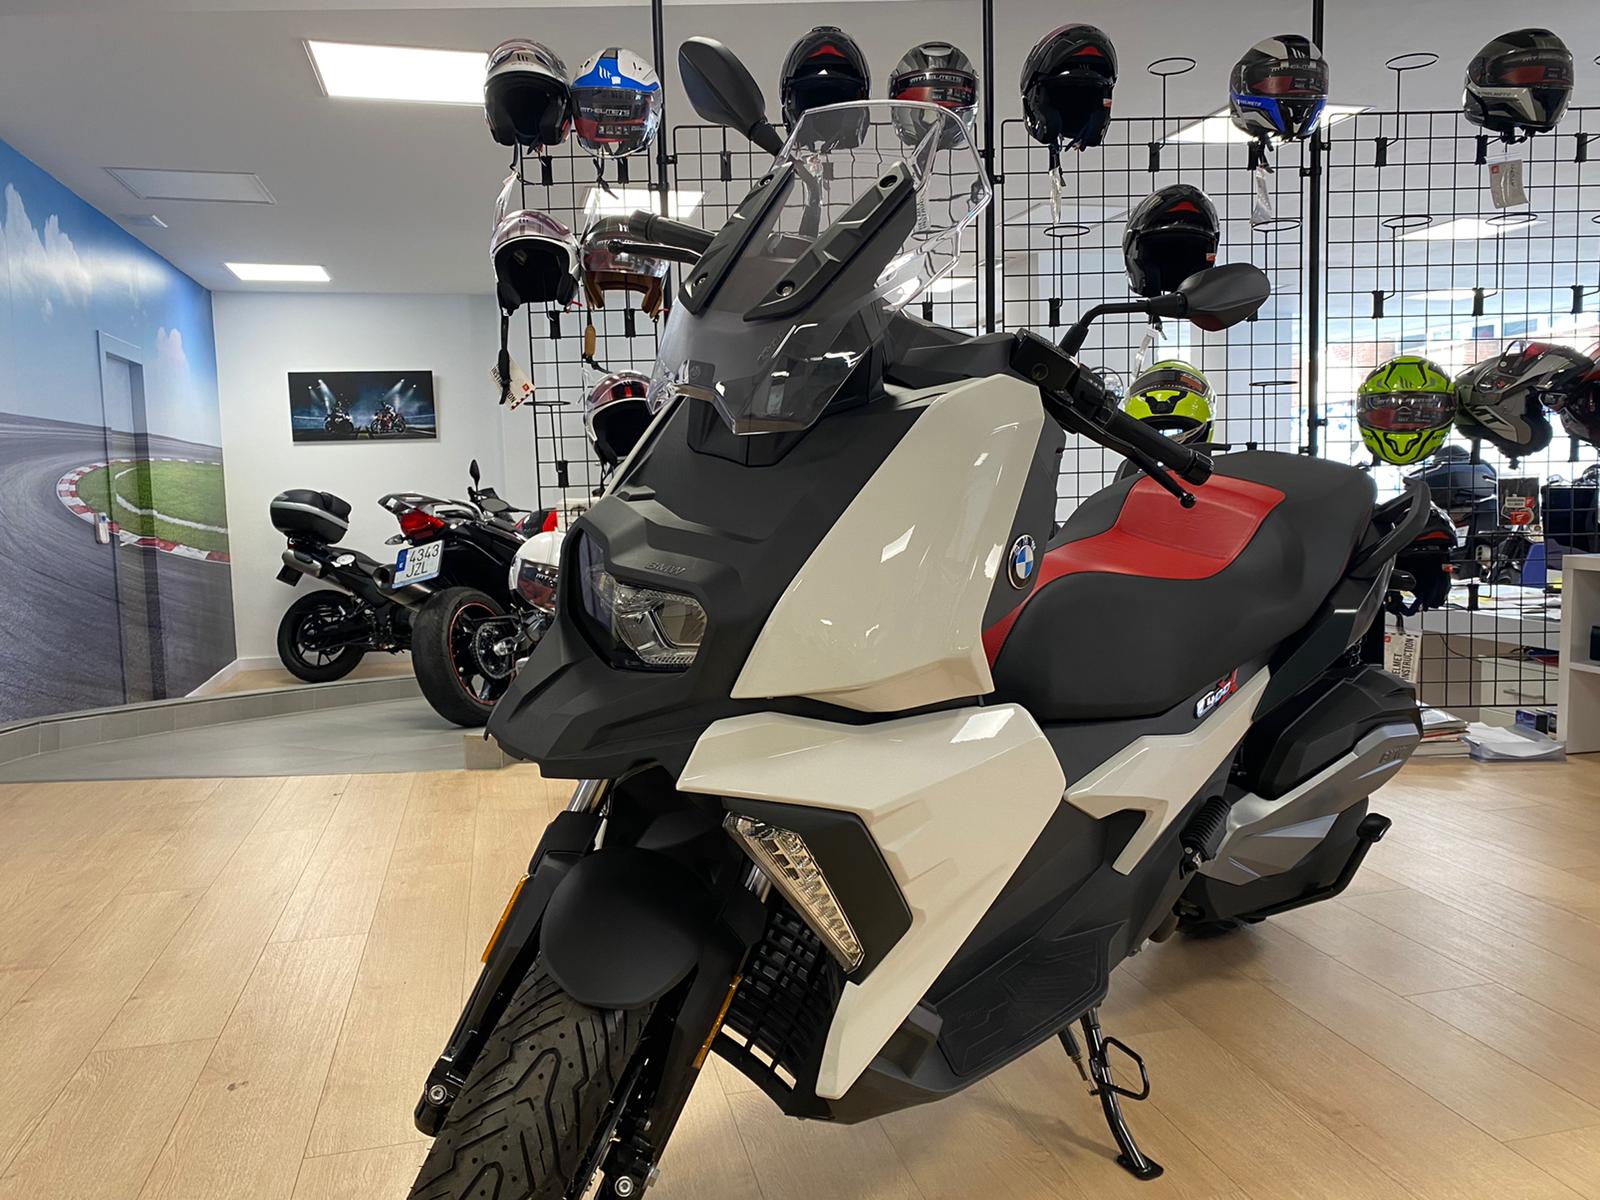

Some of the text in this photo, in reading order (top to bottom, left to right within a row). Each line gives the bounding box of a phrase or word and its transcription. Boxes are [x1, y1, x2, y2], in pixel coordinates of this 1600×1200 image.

[409, 543, 440, 562] 4343
[405, 561, 428, 578] JZL
[643, 561, 687, 575] BMW
[1391, 653, 1403, 675] ELMET
[1401, 637, 1414, 679] NSTRUCTION
